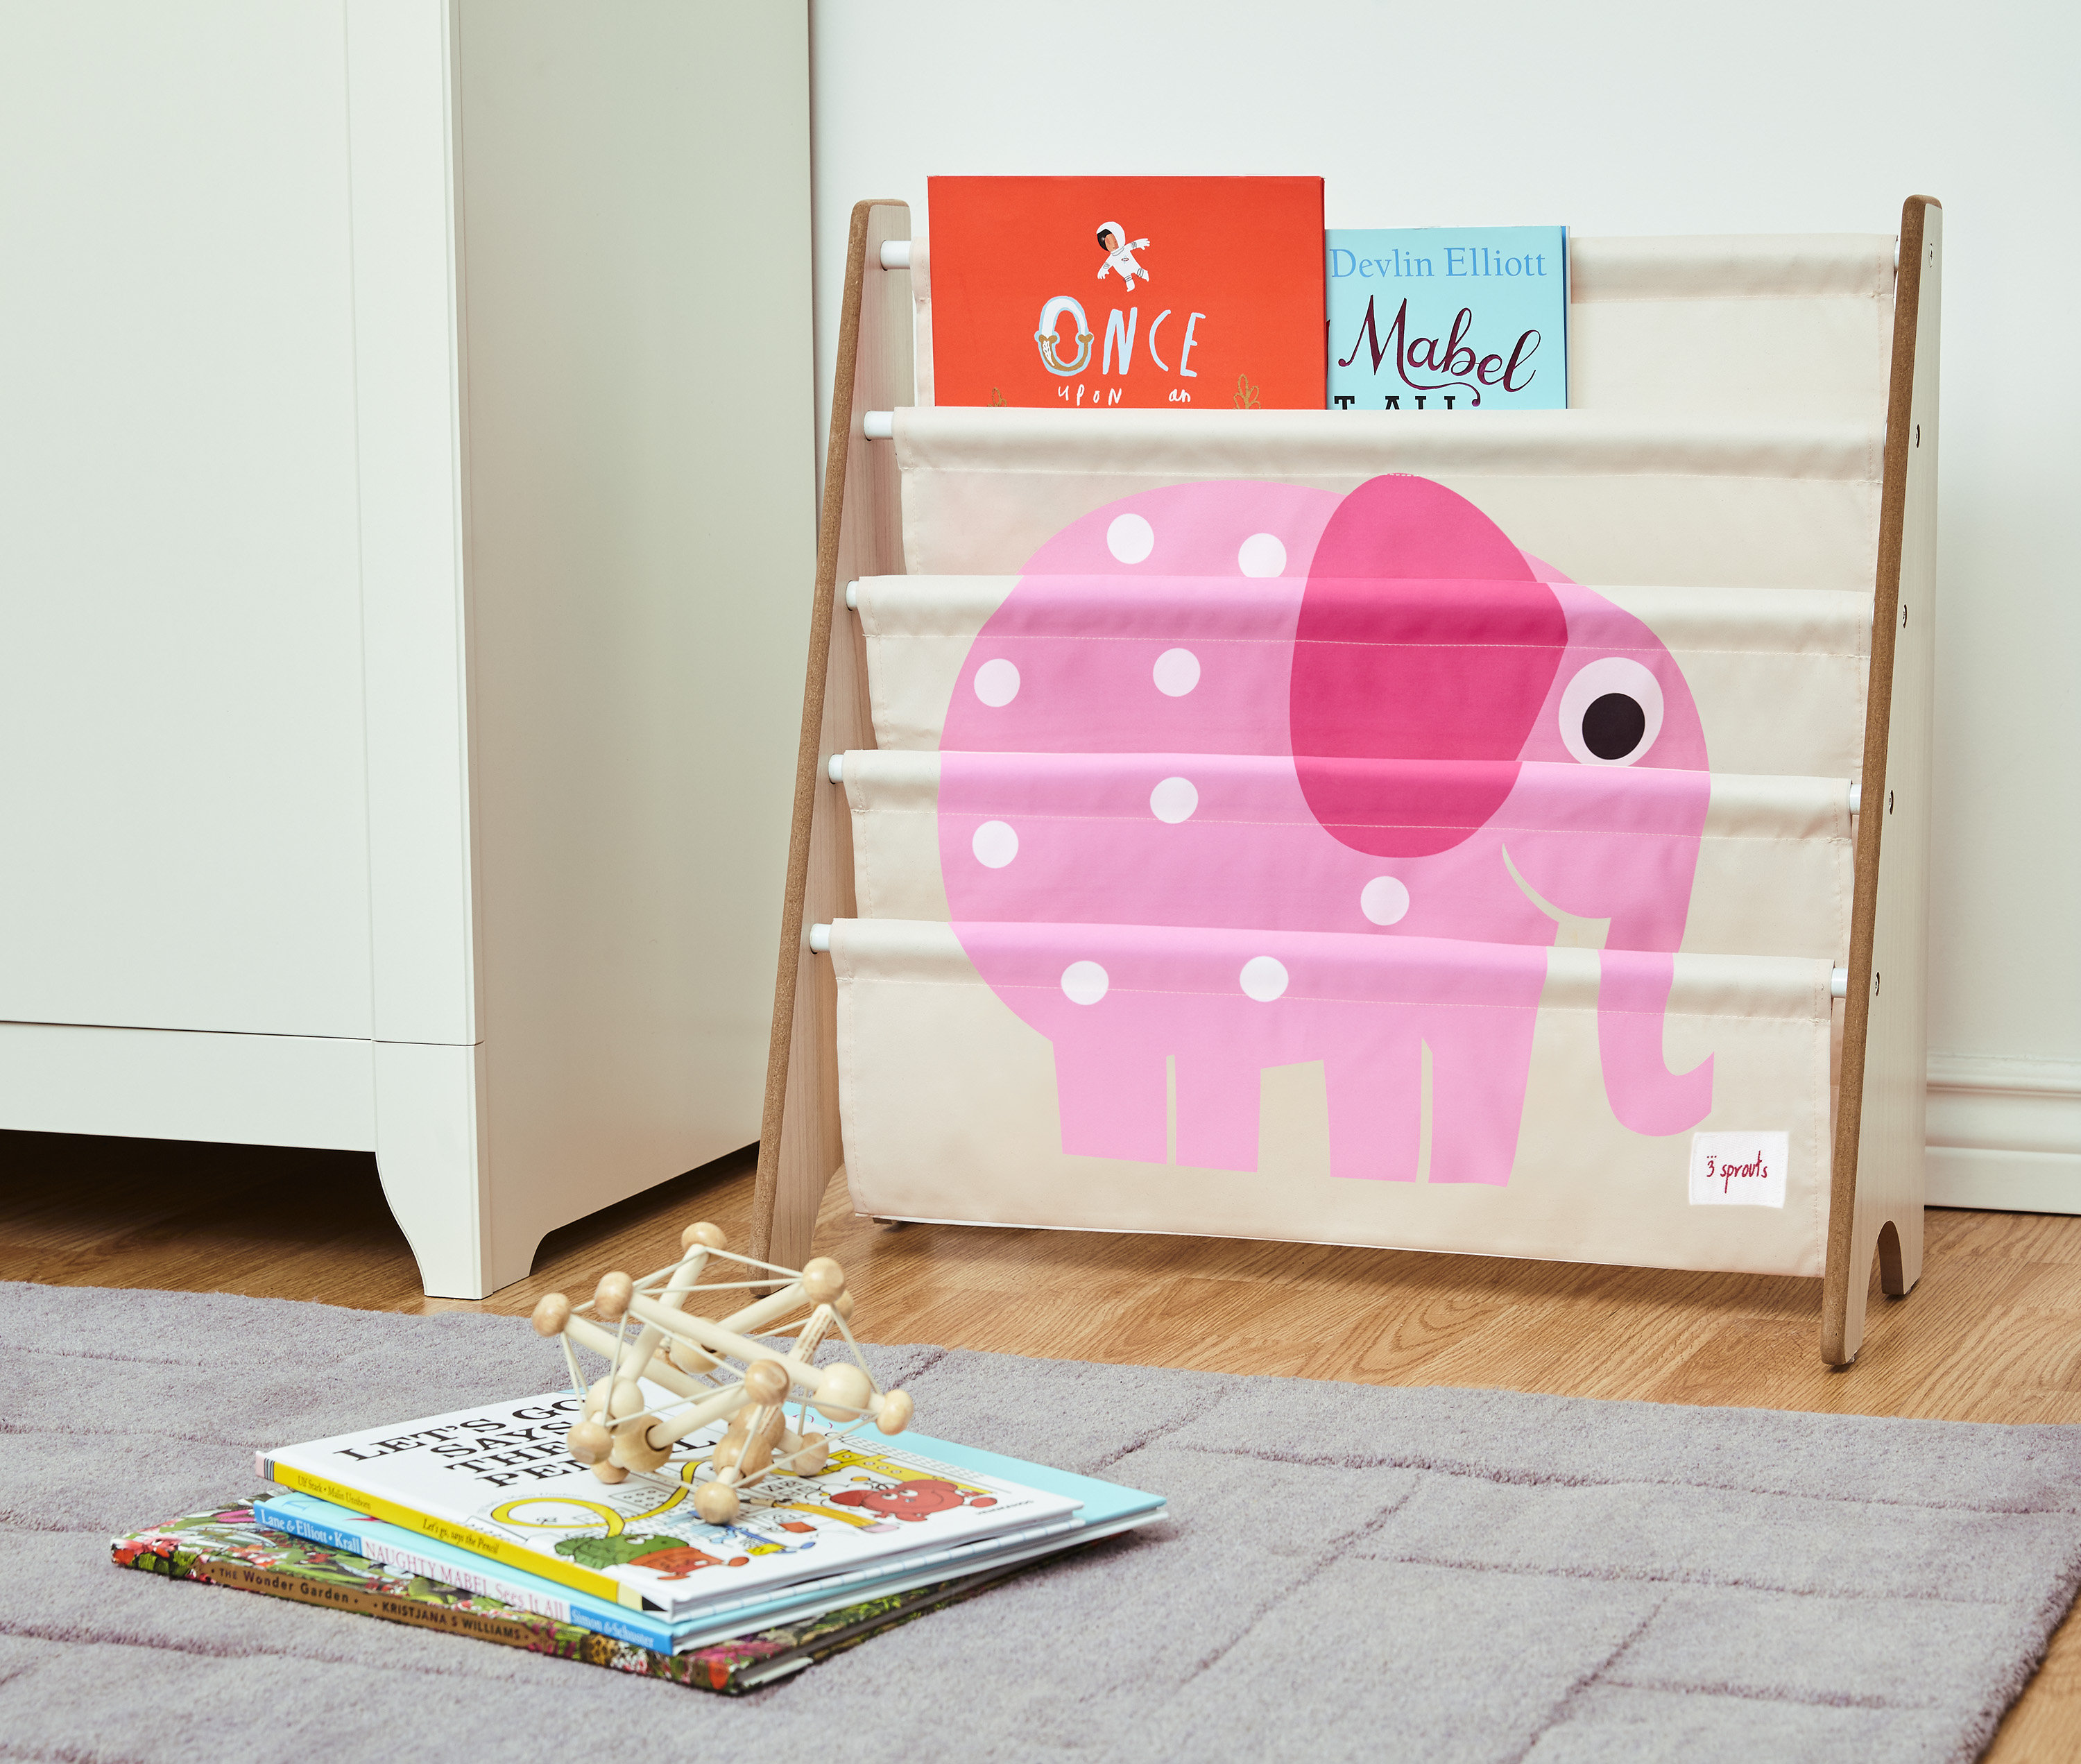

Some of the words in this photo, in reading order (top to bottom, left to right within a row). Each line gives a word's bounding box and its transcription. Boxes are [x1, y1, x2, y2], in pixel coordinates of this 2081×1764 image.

[1329, 248, 1435, 277] Devlin
[1444, 247, 1547, 277] Elliott
[1034, 296, 1206, 377] ONCE
[1338, 295, 1541, 406] Mabel
[1706, 1156, 1717, 1177] 3
[1720, 1150, 1767, 1193] sprouts
[332, 1419, 506, 1461] LET'S
[430, 1421, 573, 1458] SAYS
[443, 1441, 569, 1473] THE
[260, 1509, 285, 1529] Lane
[286, 1520, 296, 1532] &
[334, 1531, 361, 1553] Krall
[465, 1533, 476, 1545] the
[477, 1537, 499, 1554] Pencil
[219, 1568, 237, 1580] THE
[243, 1570, 294, 1591] Wonder
[300, 1582, 349, 1603] Garden
[365, 1541, 436, 1578] NAUGHTY
[440, 1566, 491, 1596] MABEL
[495, 1582, 524, 1607] Sees
[545, 1600, 564, 1620] All
[382, 1601, 448, 1626] KRISTJANA
[452, 1615, 458, 1627] S
[461, 1618, 521, 1640] WILLIAMS
